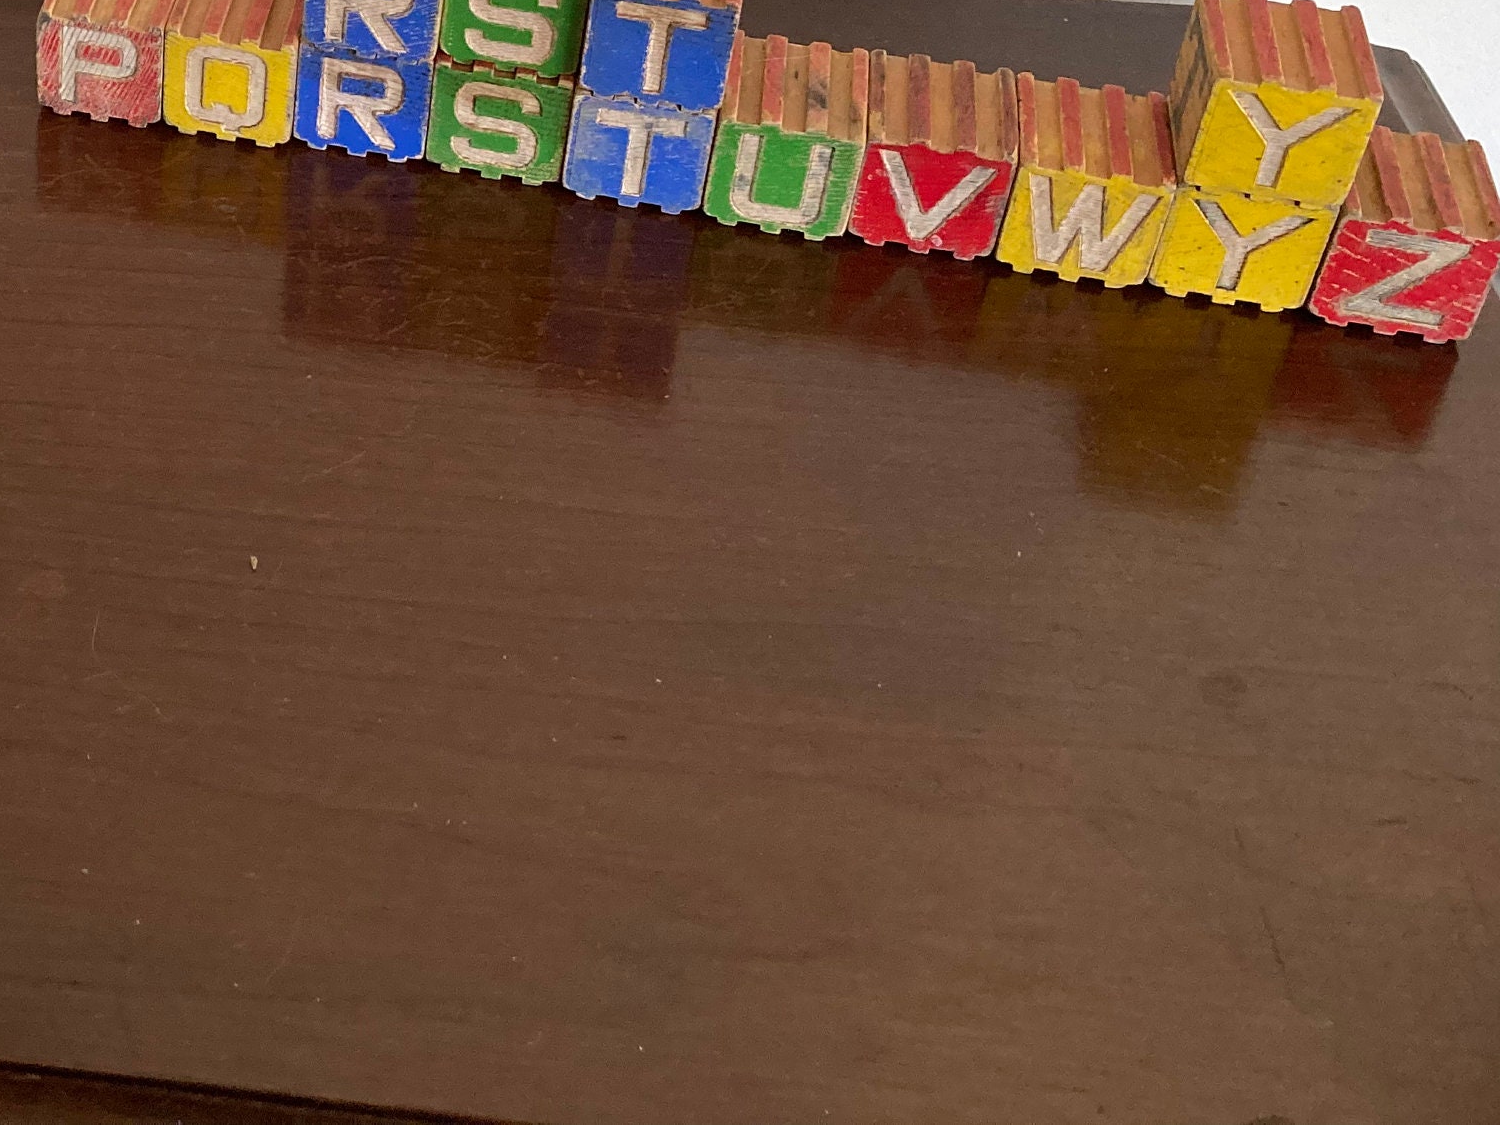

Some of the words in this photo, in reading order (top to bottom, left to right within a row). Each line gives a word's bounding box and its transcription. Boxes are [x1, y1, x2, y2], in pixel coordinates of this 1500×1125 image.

[58, 26, 139, 102] P
[185, 45, 268, 133] Q
[615, 0, 709, 95] T
[316, 58, 404, 150] R
[450, 82, 542, 168] S
[1228, 90, 1360, 188] Y
[596, 108, 688, 197] T
[730, 133, 834, 225] U
[879, 148, 999, 241] V
[1028, 172, 1162, 272] W
[1192, 197, 1316, 291] Y
[1336, 228, 1474, 327] Z
